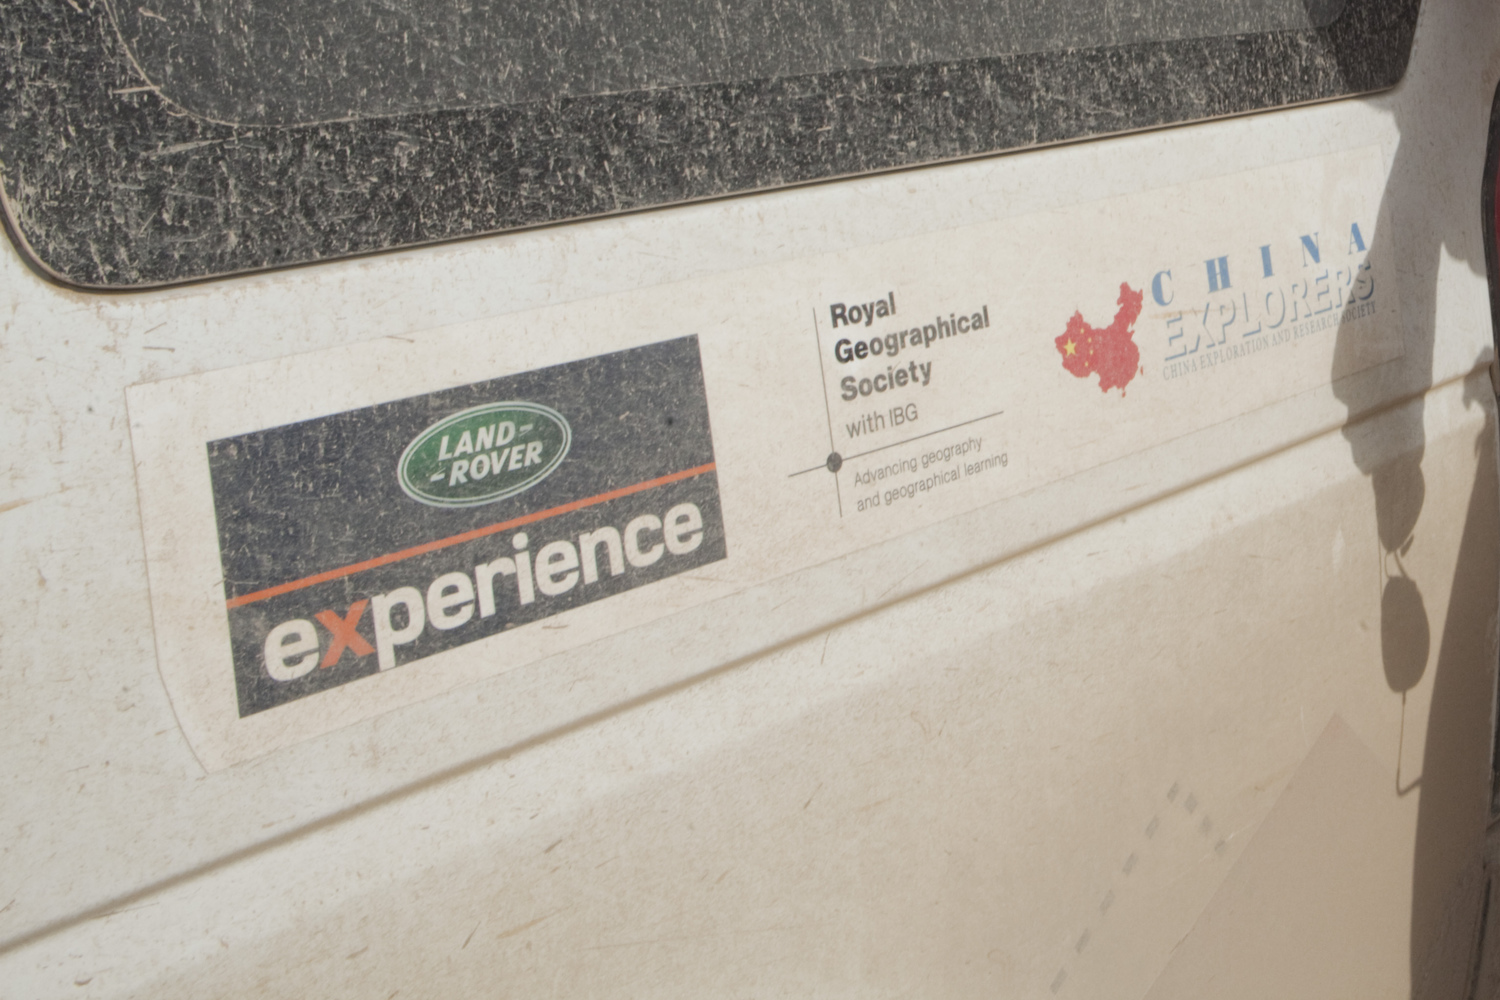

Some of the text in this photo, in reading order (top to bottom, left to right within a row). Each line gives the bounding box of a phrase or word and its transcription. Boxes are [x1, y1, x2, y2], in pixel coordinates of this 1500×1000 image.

[1151, 222, 1367, 307] CHINA
[829, 291, 897, 328] Royal
[834, 304, 990, 364] Geographical
[1164, 259, 1375, 362] EXPLORERS
[1162, 301, 1377, 382] CHINA EXPLORATION AND RESEARCH SOCIETY
[840, 361, 932, 401] Society
[436, 420, 516, 462] LAND
[846, 403, 918, 438] with IBG
[448, 440, 543, 487] ROVER
[854, 436, 982, 487] Advancing geography
[857, 452, 1008, 512] and geographical learning
[263, 502, 704, 682] experience
